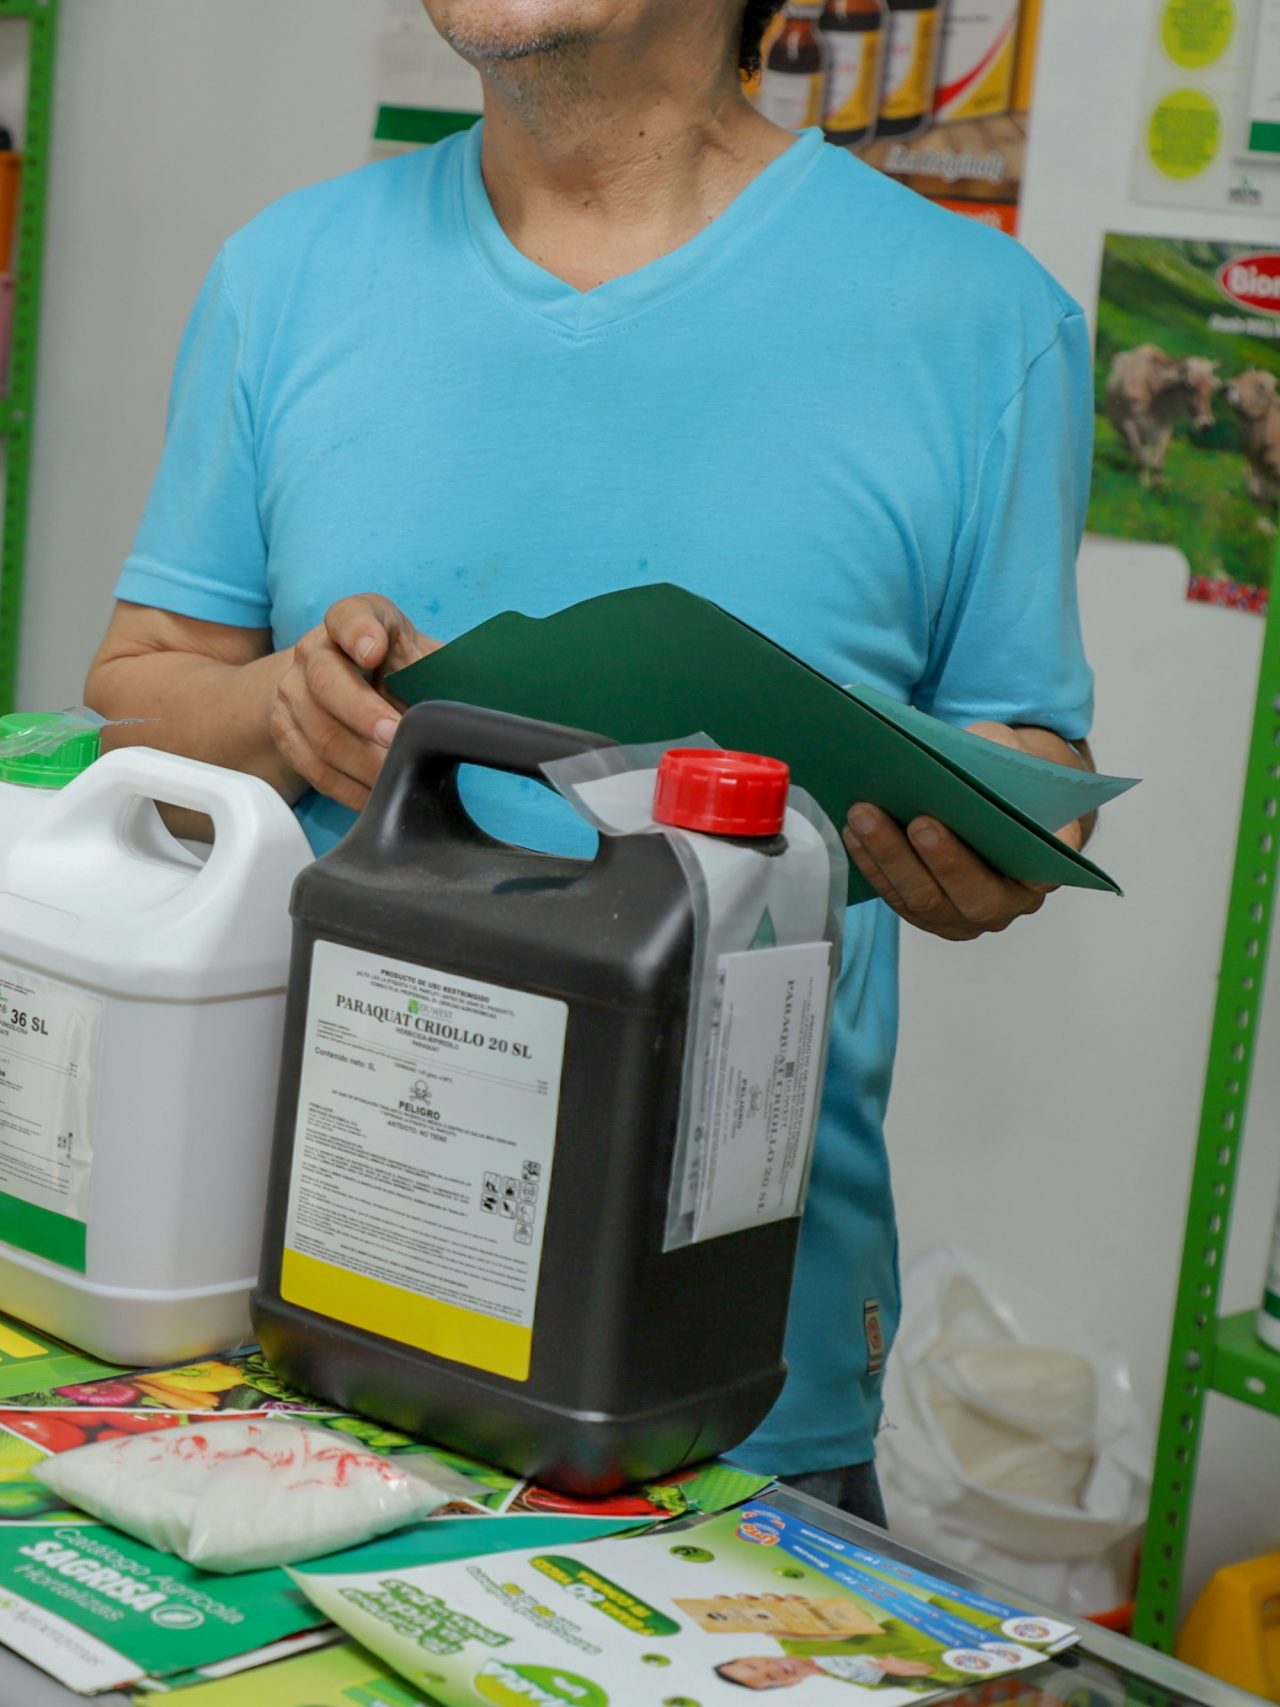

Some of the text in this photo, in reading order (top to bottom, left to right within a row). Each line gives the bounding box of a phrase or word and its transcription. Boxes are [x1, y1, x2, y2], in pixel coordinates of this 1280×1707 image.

[380, 969, 415, 984] PRODUCTO
[417, 978, 425, 986] DE
[10, 1007, 27, 1027] 36
[30, 1015, 48, 1036] SL
[335, 993, 411, 1029] PARAQUAT
[414, 1015, 485, 1048] CRIOLLO
[488, 1035, 508, 1054] 20
[511, 1041, 532, 1059] SL
[777, 979, 795, 1075] PARAQUAT
[314, 1046, 348, 1064] Contenido
[398, 1100, 440, 1121] PELIGRO
[767, 1081, 784, 1163] CRIOLLO
[19, 1540, 168, 1612] SAGRISA
[54, 1528, 151, 1576] Catálogo
[15, 1563, 124, 1622] Hortalizas
